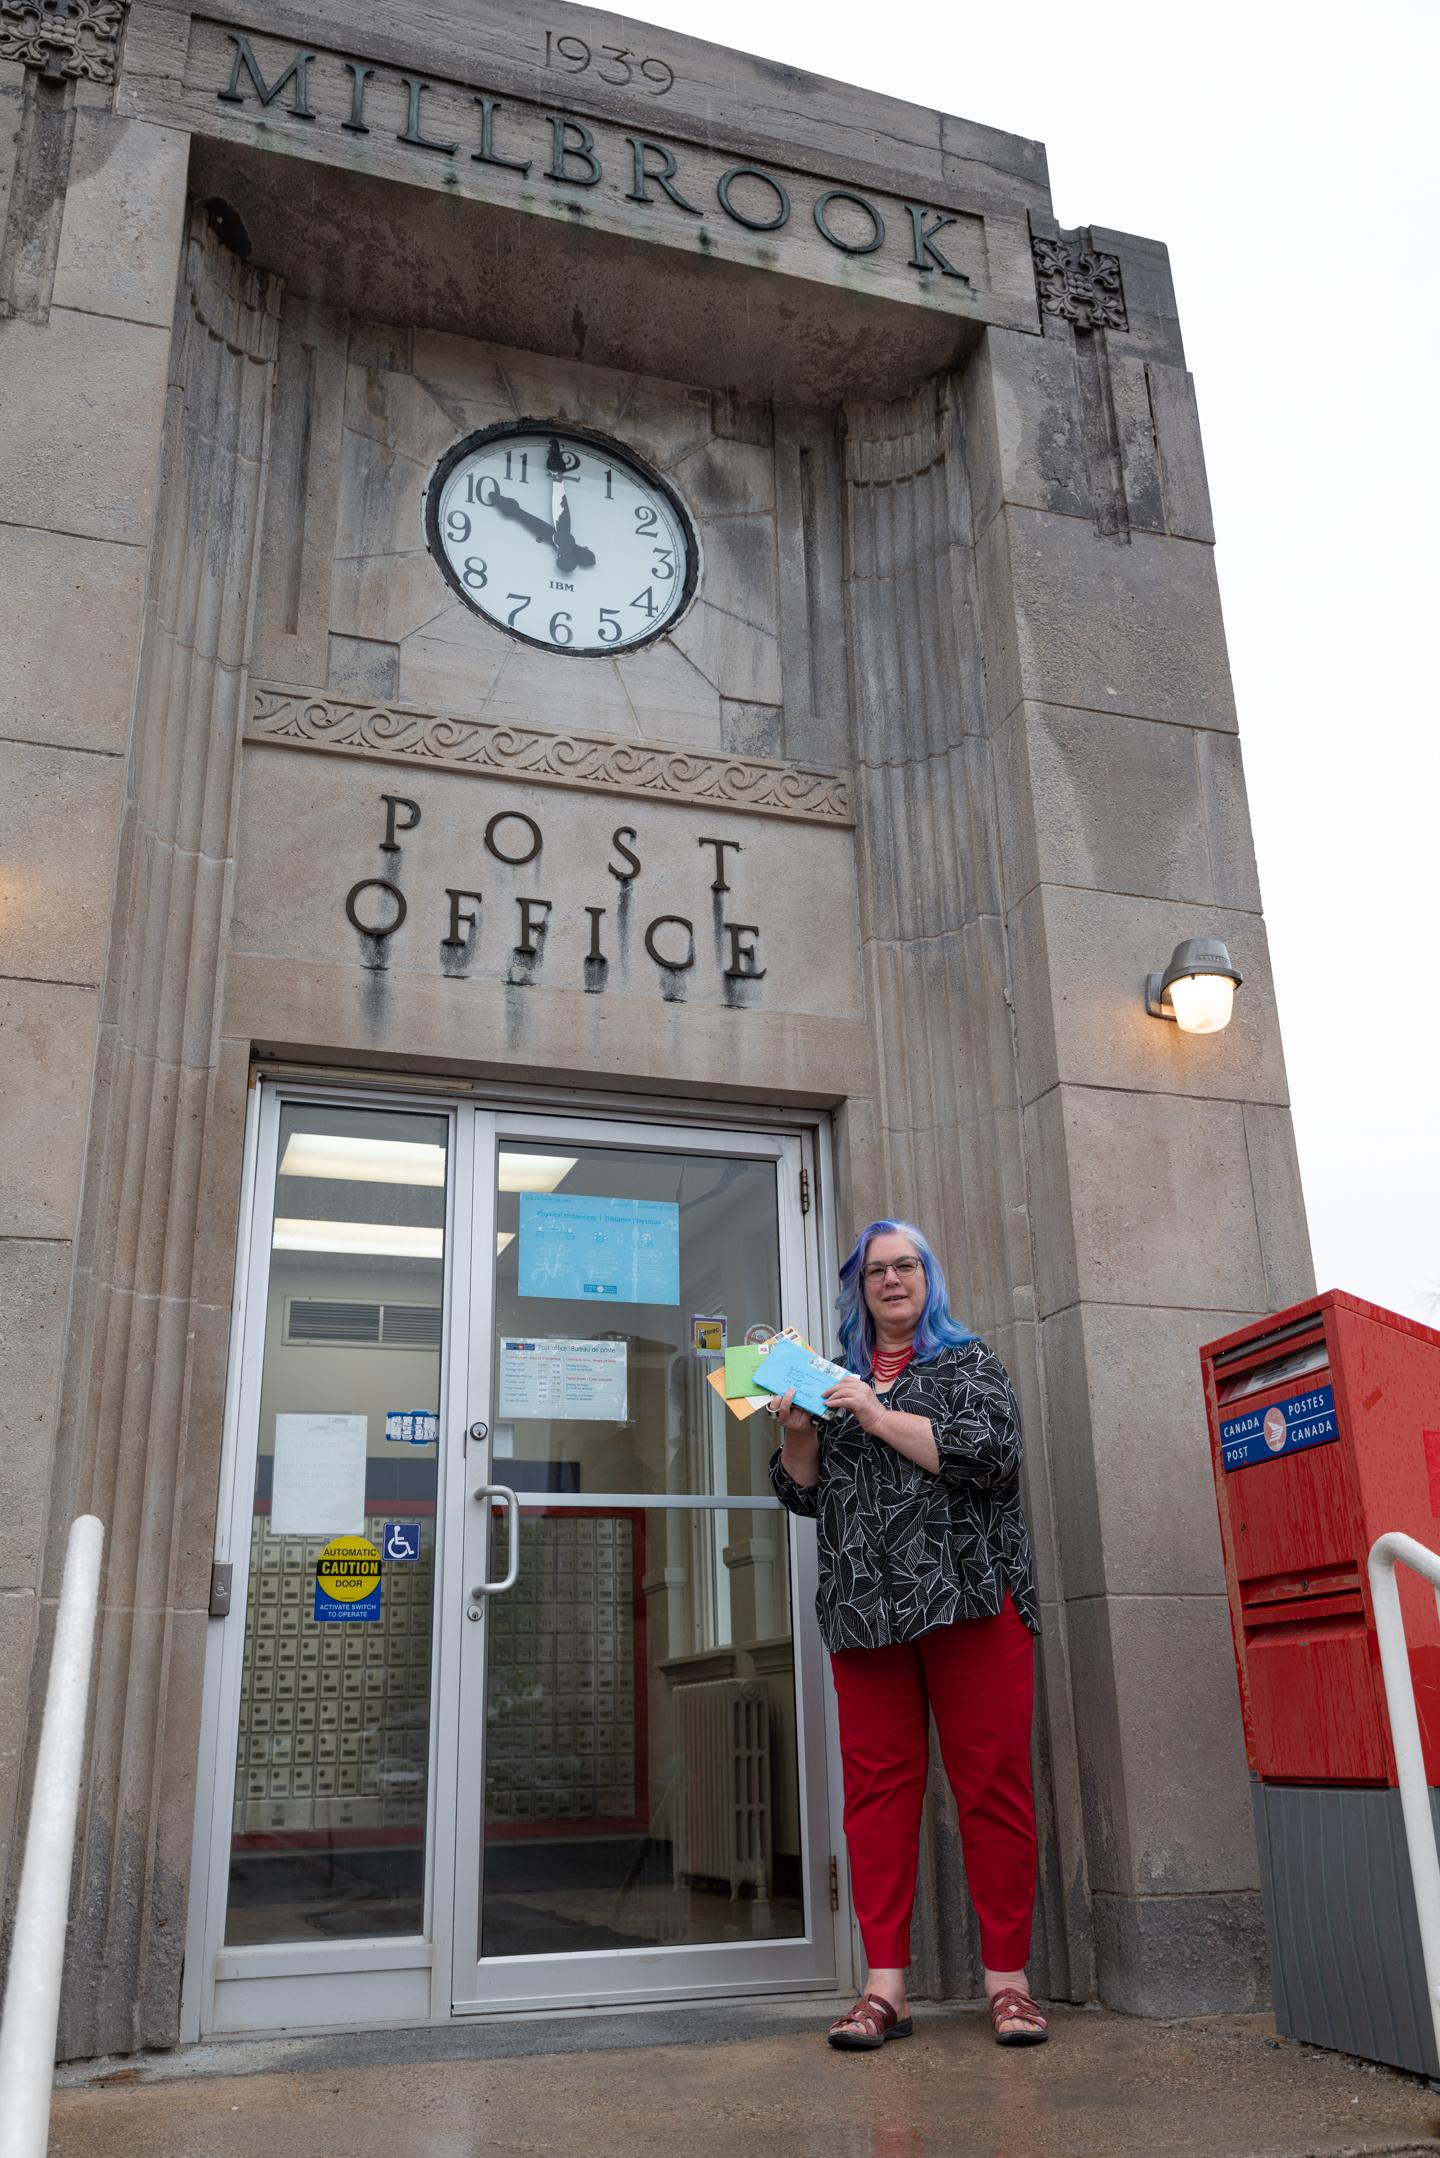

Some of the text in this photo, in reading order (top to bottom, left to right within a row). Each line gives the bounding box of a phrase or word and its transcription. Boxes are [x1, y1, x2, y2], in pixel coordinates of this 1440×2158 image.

[545, 31, 675, 96] 1939
[217, 34, 969, 281] MILLBROOK
[503, 450, 529, 484] 11
[465, 472, 500, 507] 10
[604, 469, 614, 500] 1
[447, 510, 471, 543] 9
[634, 506, 659, 538] 2
[463, 556, 488, 589] 8
[651, 547, 674, 580] 3
[549, 581, 574, 592] IBM
[629, 586, 659, 618] 4
[506, 593, 531, 627] 7
[597, 607, 622, 642] 5
[549, 611, 573, 645] 6
[379, 794, 740, 891] POST
[346, 878, 767, 979] OFFICE
[537, 1210, 661, 1226] Physical distancing Distance physique
[1288, 1394, 1324, 1416] POSTES
[1223, 1416, 1260, 1438] CANADA
[1291, 1420, 1332, 1442] CANADA
[1227, 1446, 1249, 1462] POST
[321, 1561, 379, 1575] CAUTION
[323, 1548, 377, 1556] AUTOMATIC
[335, 1579, 363, 1588] DOOR
